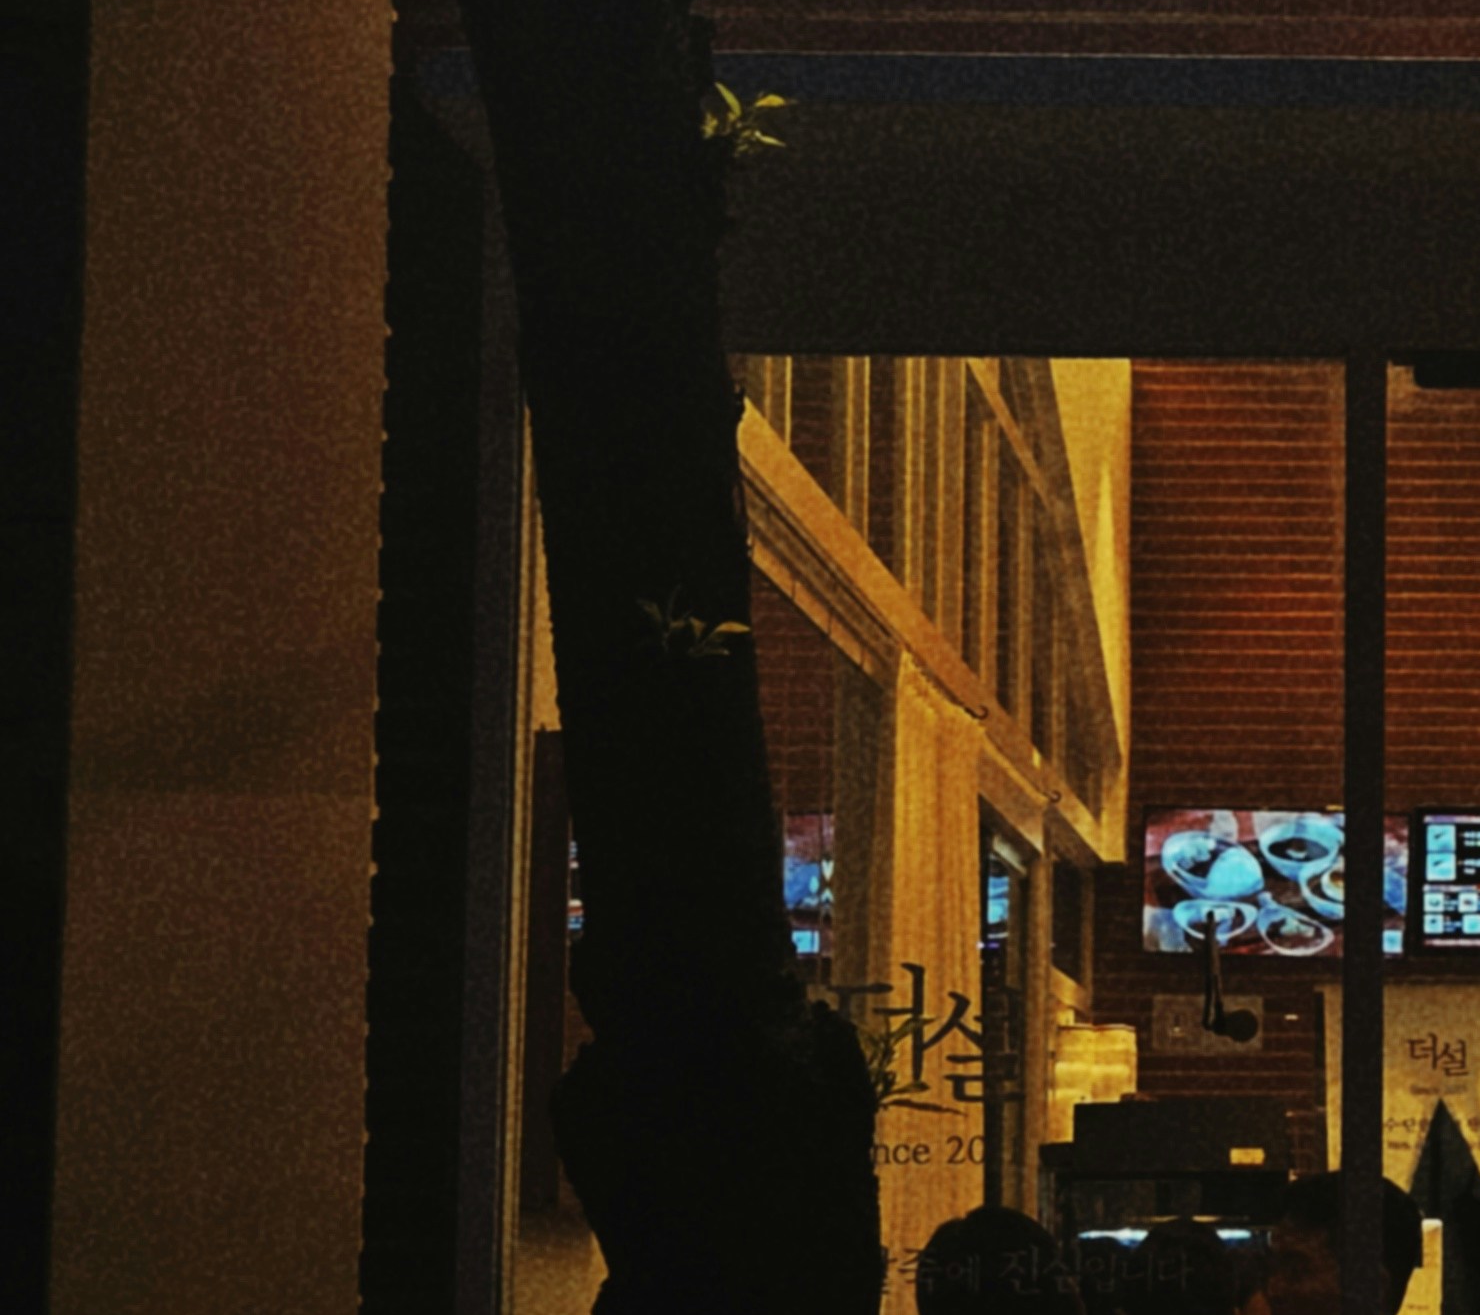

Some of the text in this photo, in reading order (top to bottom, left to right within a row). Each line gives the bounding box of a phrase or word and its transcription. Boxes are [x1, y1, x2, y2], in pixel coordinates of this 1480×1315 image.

[1406, 1030, 1469, 1078] 더설
[871, 1134, 986, 1166] nce 20
[998, 1240, 1195, 1295] 진심입니다
